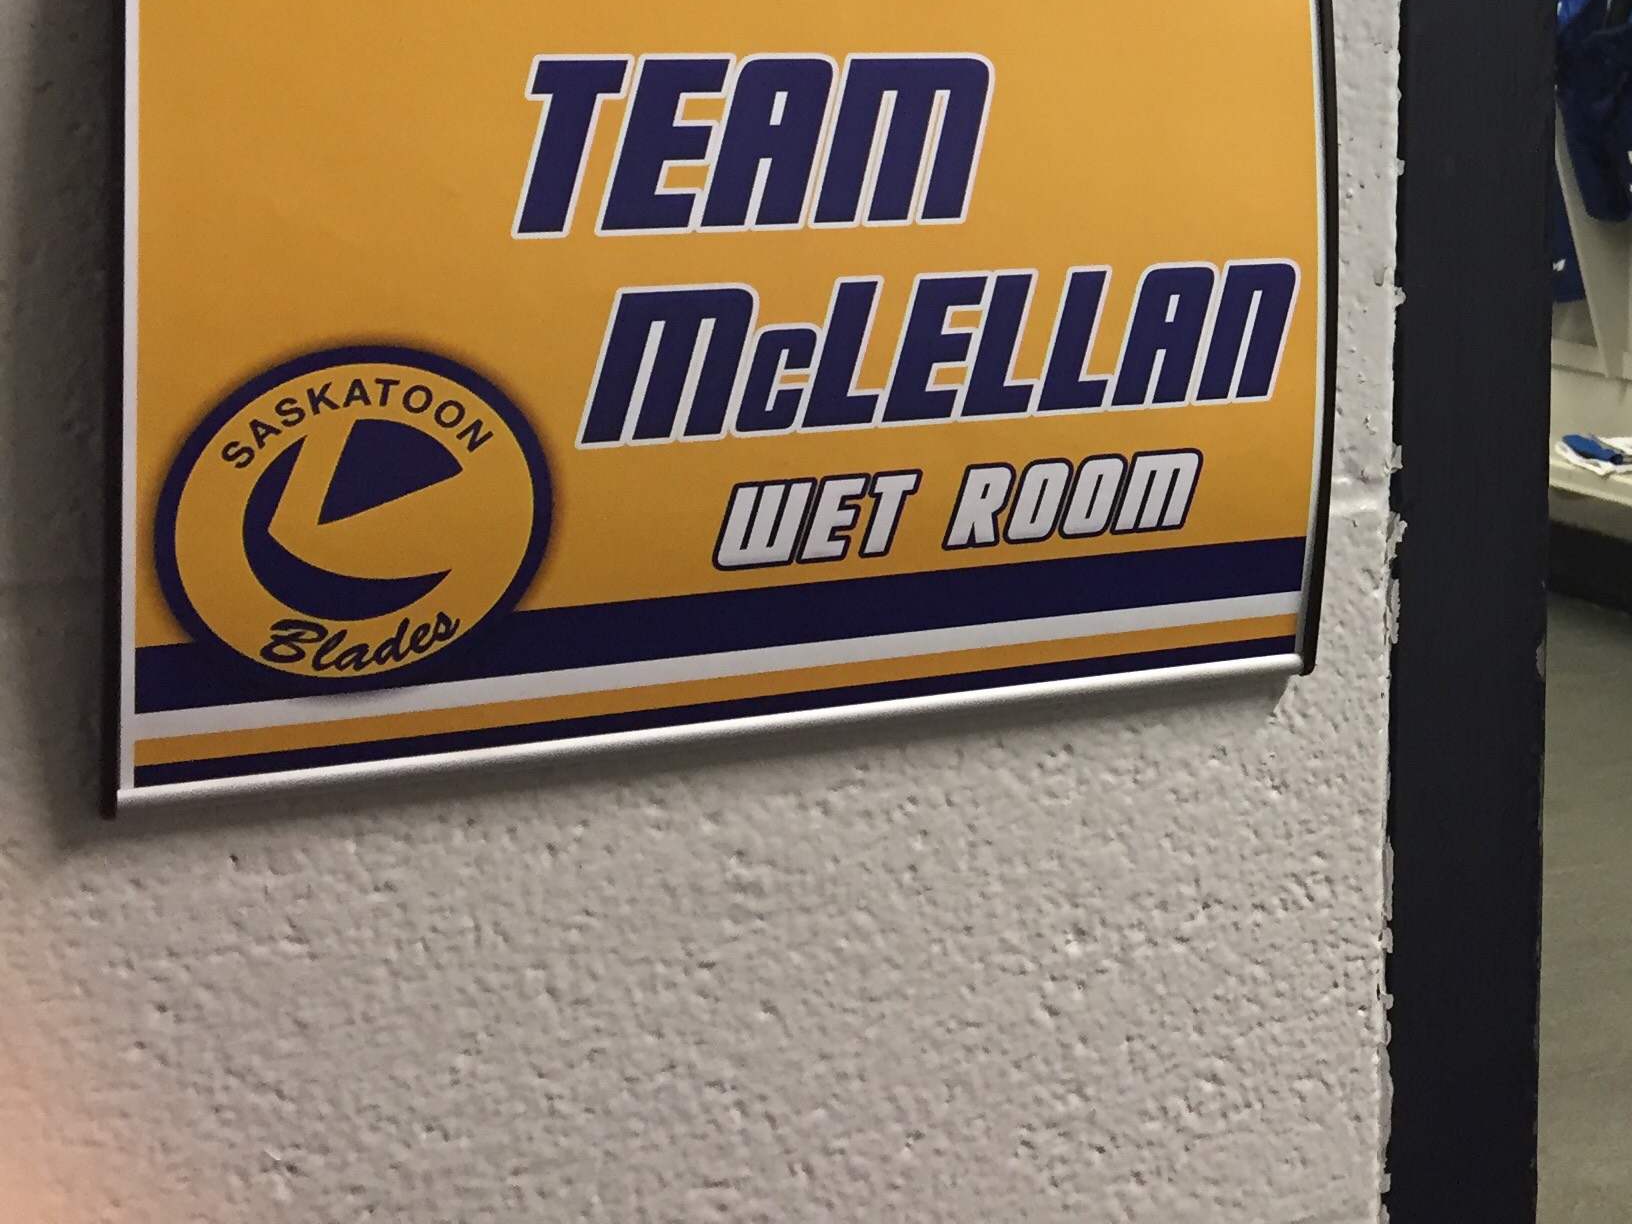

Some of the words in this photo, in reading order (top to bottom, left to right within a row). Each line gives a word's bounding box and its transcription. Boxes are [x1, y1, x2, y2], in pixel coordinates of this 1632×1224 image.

[510, 52, 995, 239] TEAM
[574, 258, 1302, 450] McLELLAN
[221, 377, 494, 470] SASKATOON
[712, 469, 922, 571] WET
[943, 447, 1205, 551] ROOM
[258, 611, 461, 672] Blades
